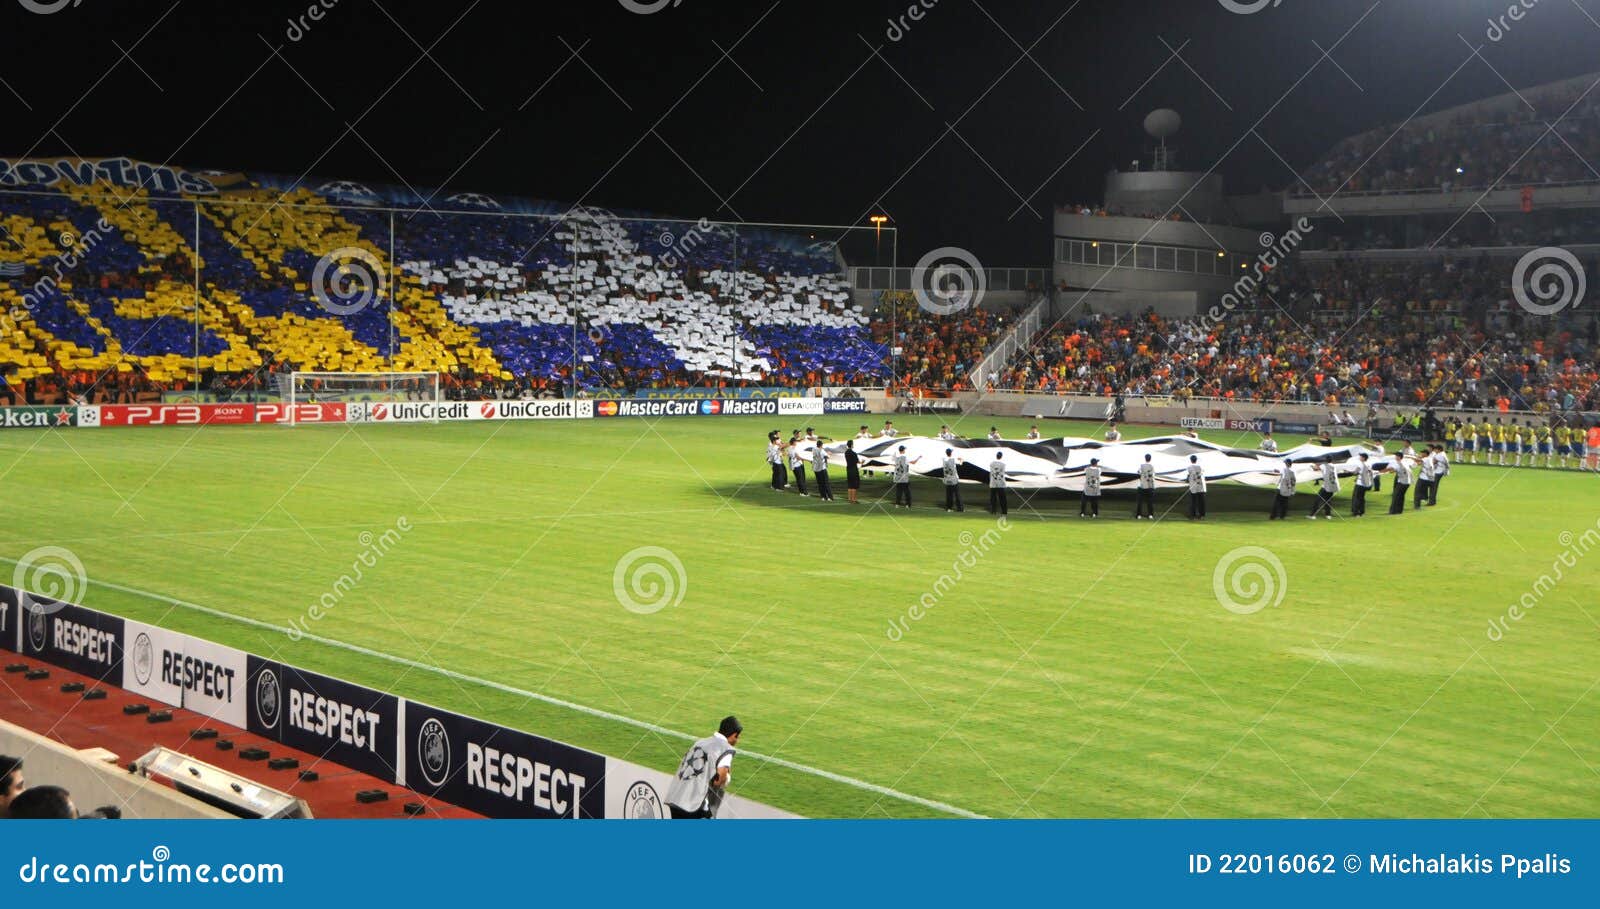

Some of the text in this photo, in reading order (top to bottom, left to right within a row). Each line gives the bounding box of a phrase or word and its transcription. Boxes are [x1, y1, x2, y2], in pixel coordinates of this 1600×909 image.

[256, 405, 322, 422] PS3
[392, 402, 468, 419] UniCredit
[500, 402, 571, 418] UniCredit
[619, 400, 697, 416] MasterCard
[722, 399, 776, 415] Maestro
[831, 401, 864, 410] RESPECT
[127, 406, 200, 424] PS3
[1231, 420, 1263, 430] SONY
[54, 618, 115, 665] RESPECT
[162, 649, 234, 703] RESPECT
[290, 688, 380, 752] RESPECT
[424, 723, 443, 740] UEFA
[467, 742, 585, 819] RESPECT
[631, 786, 655, 805] UEFA
